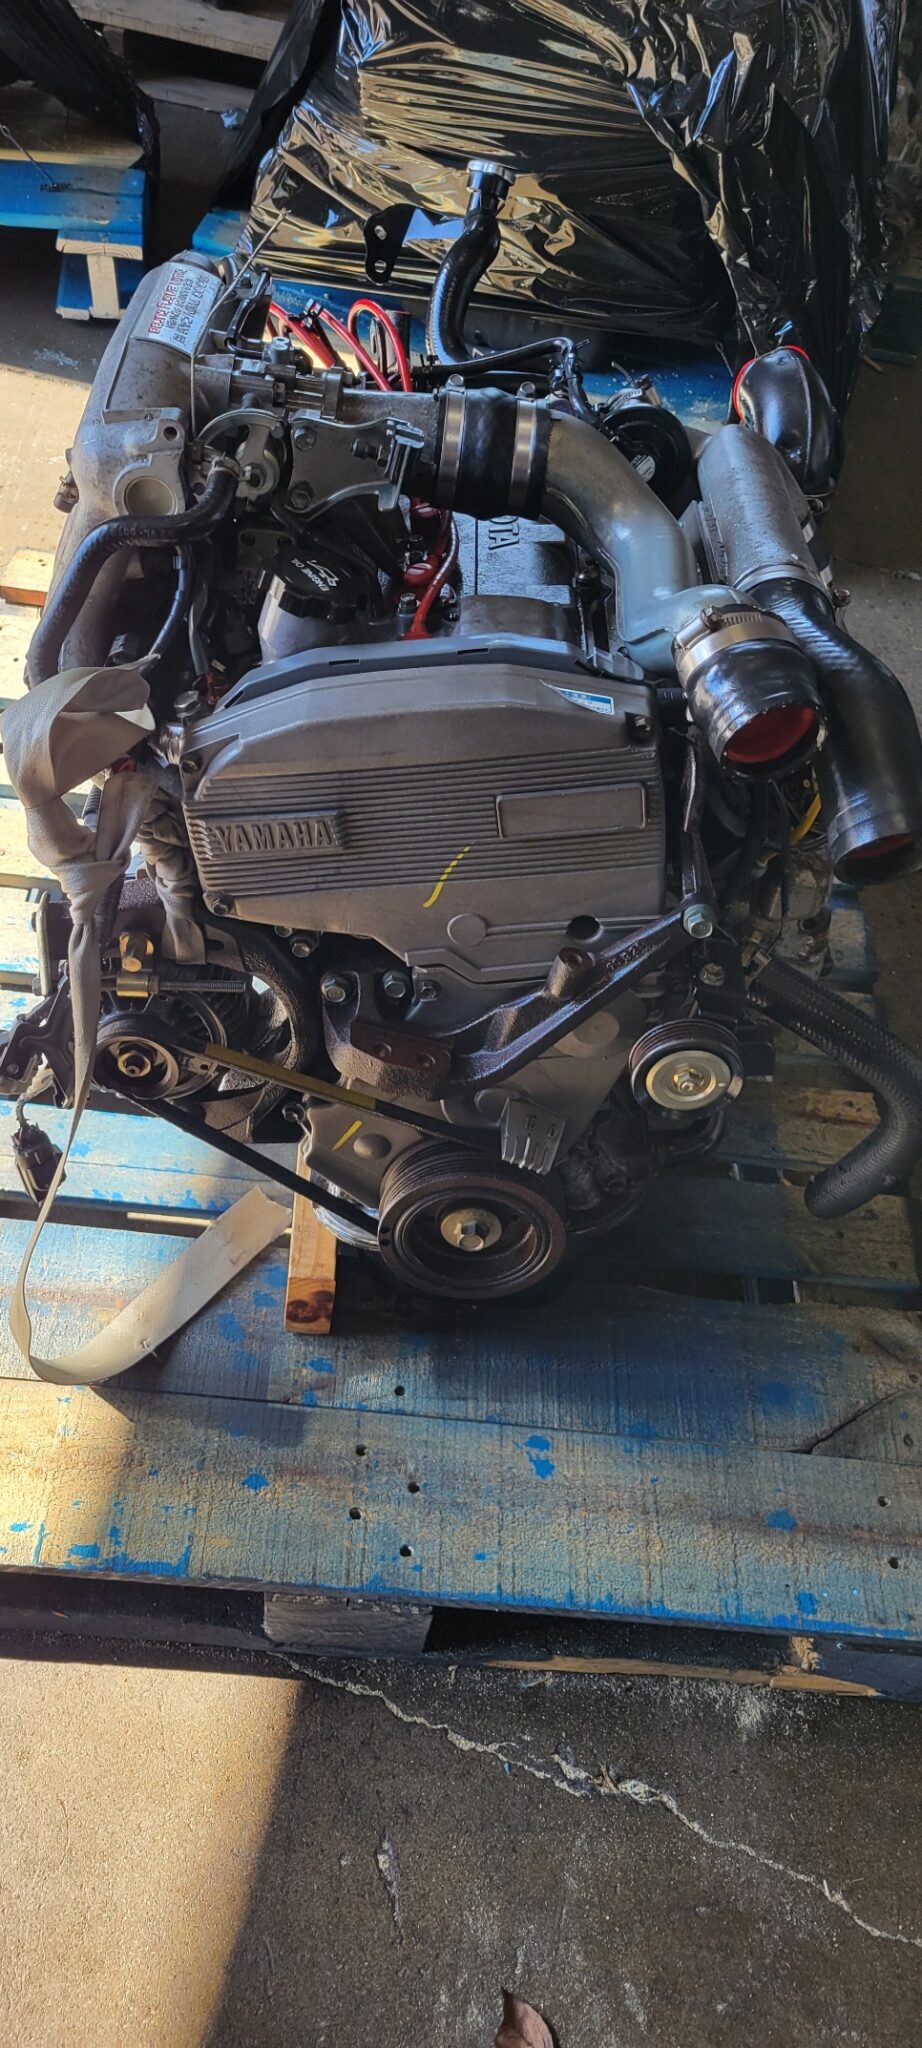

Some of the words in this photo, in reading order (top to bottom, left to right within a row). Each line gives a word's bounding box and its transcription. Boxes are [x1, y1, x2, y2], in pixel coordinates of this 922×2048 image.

[290, 558, 304, 568] OIL
[301, 568, 330, 592] ENGINE
[214, 820, 335, 853] YAMAHA
